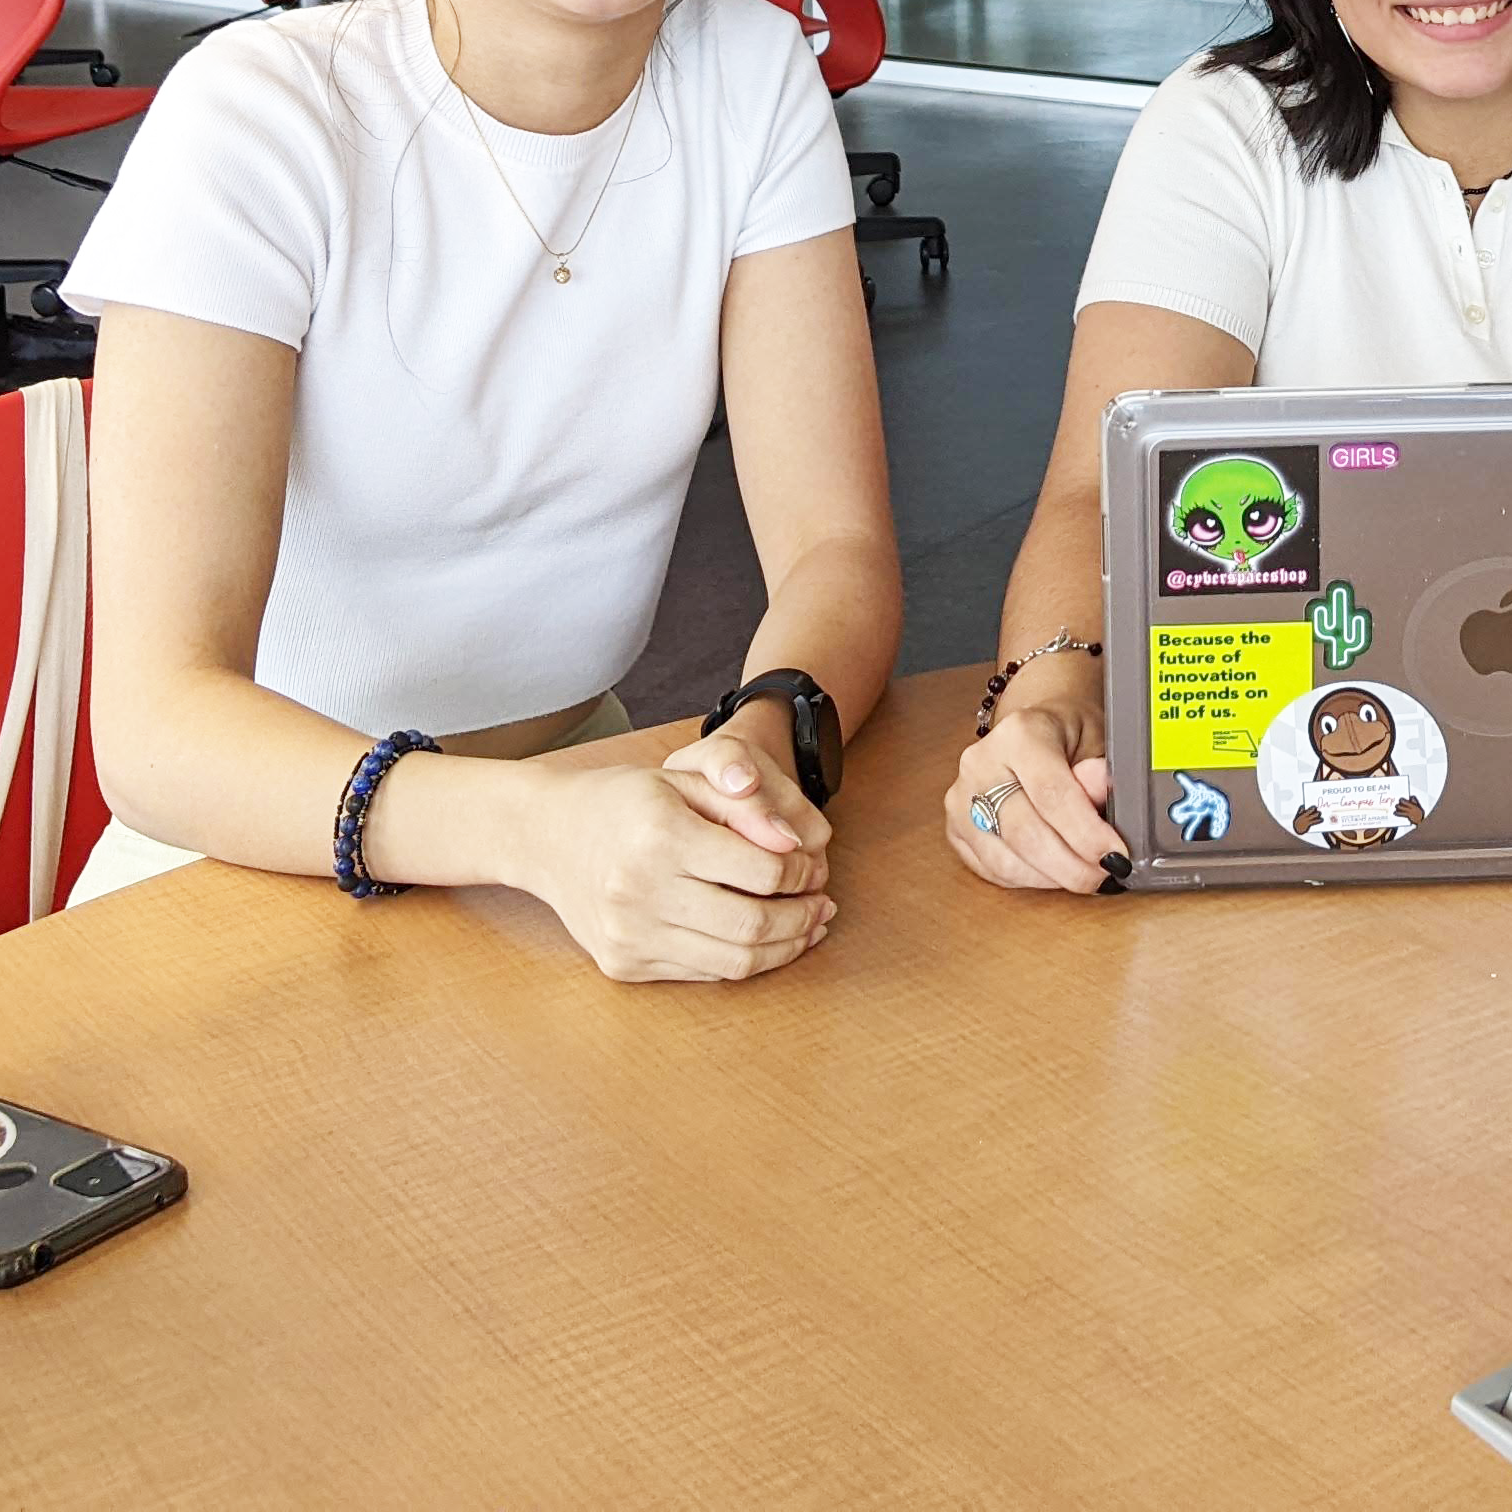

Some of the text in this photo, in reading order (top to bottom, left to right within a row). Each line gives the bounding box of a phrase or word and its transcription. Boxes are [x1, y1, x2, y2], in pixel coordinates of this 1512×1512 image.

[1332, 446, 1396, 468] GIRLS
[1166, 567, 1308, 589] @cyberspaceshop
[1158, 631, 1271, 646] Because the
[1158, 649, 1242, 664] future of
[1158, 669, 1257, 683] innovation
[1158, 687, 1268, 704] depends on
[1158, 705, 1237, 719] all of us.
[1322, 783, 1391, 795] PROUD TO BE AN
